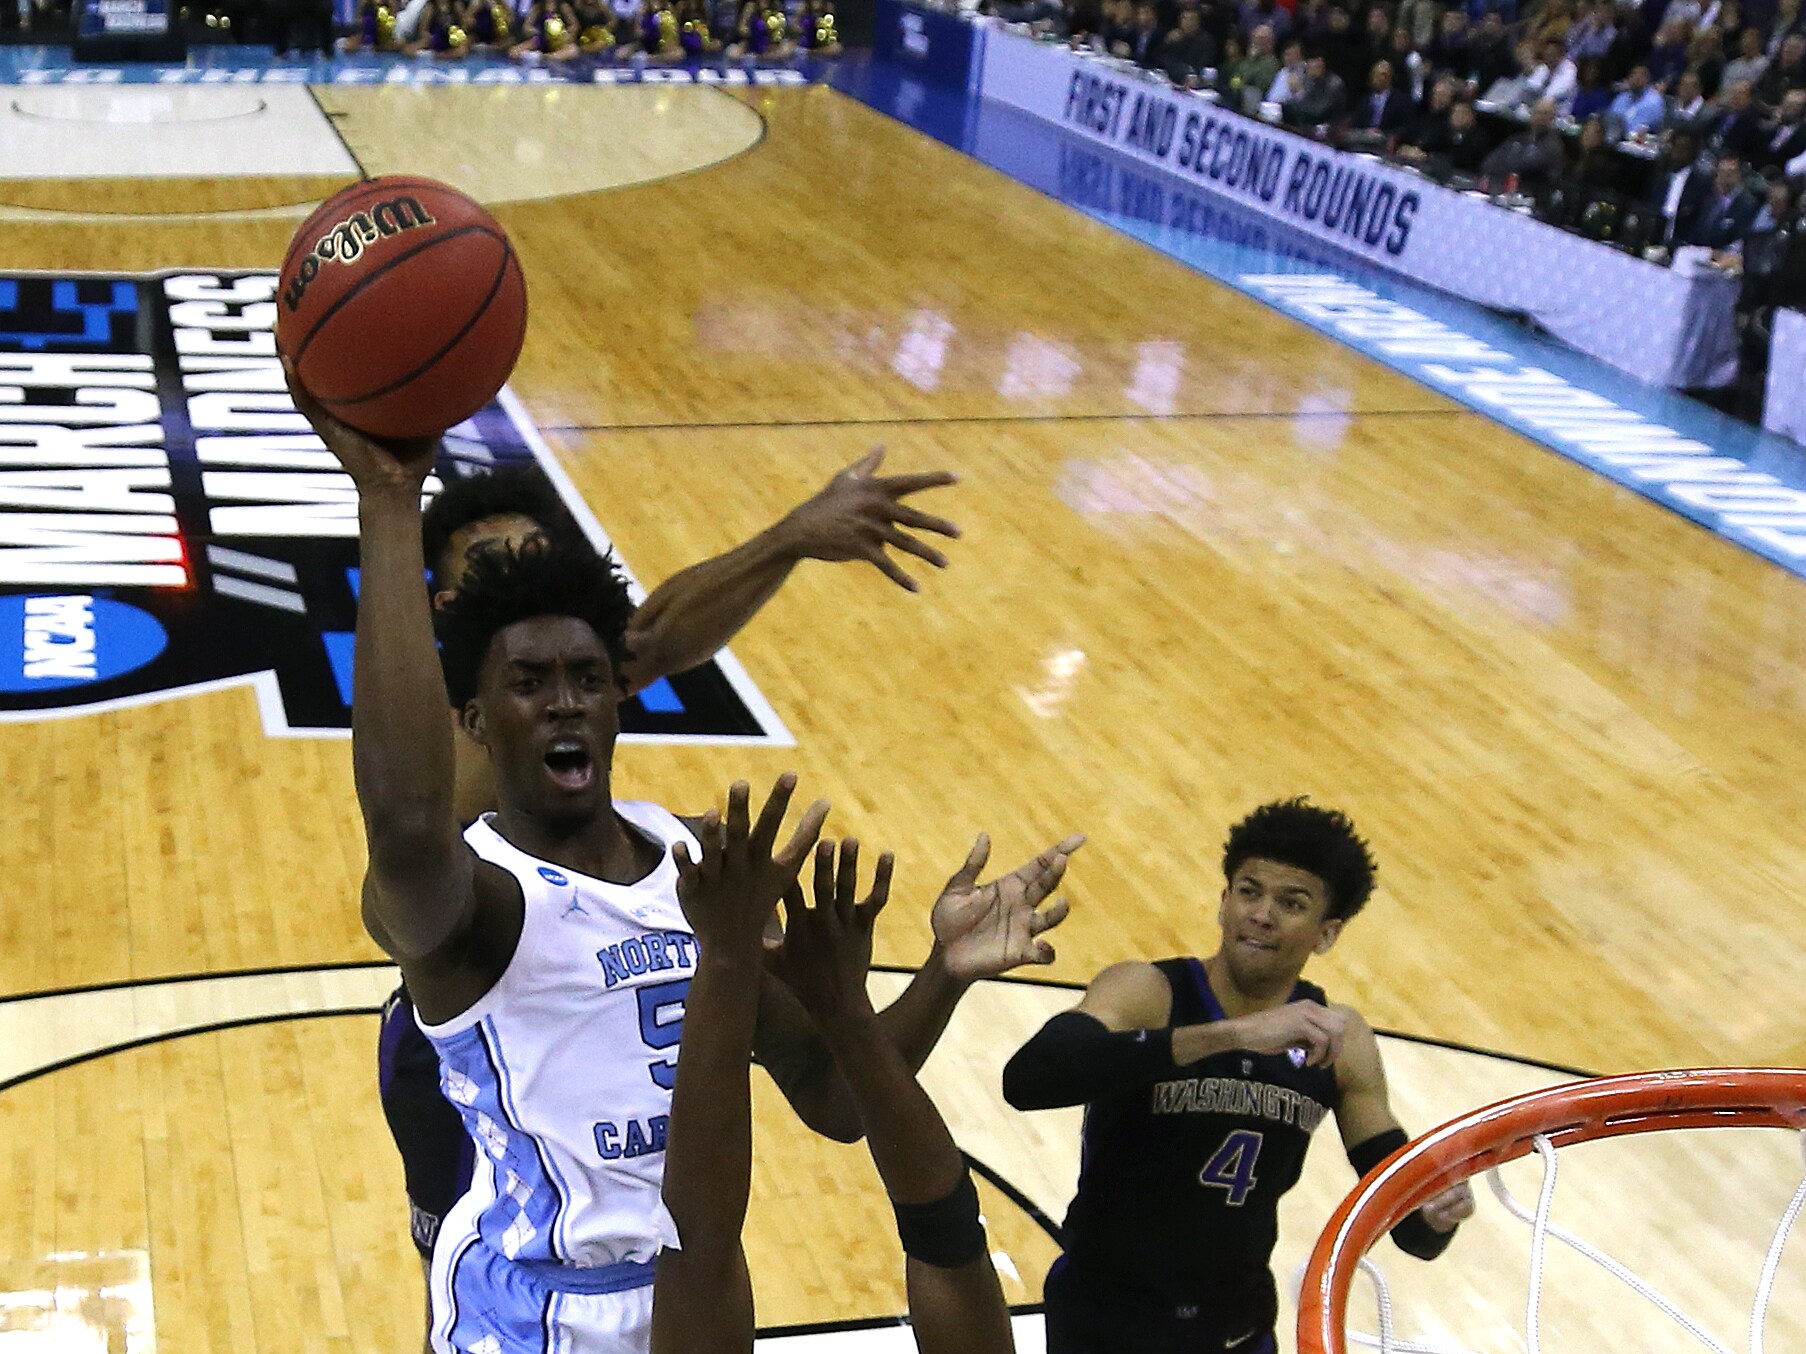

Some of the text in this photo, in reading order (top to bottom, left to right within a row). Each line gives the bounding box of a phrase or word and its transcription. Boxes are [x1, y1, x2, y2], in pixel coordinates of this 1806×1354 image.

[593, 67, 808, 84] FOUR
[1064, 68, 1127, 140] FIRST
[1125, 91, 1179, 158] AND
[1178, 108, 1287, 202] SECOND
[1282, 150, 1422, 257] ROUNDS
[284, 196, 437, 312] Wilson
[0, 350, 188, 587] MARCH
[23, 594, 98, 680] NCAA
[596, 931, 702, 988] NORT
[594, 1115, 670, 1160] CAR
[1199, 1128, 1264, 1207] 4
